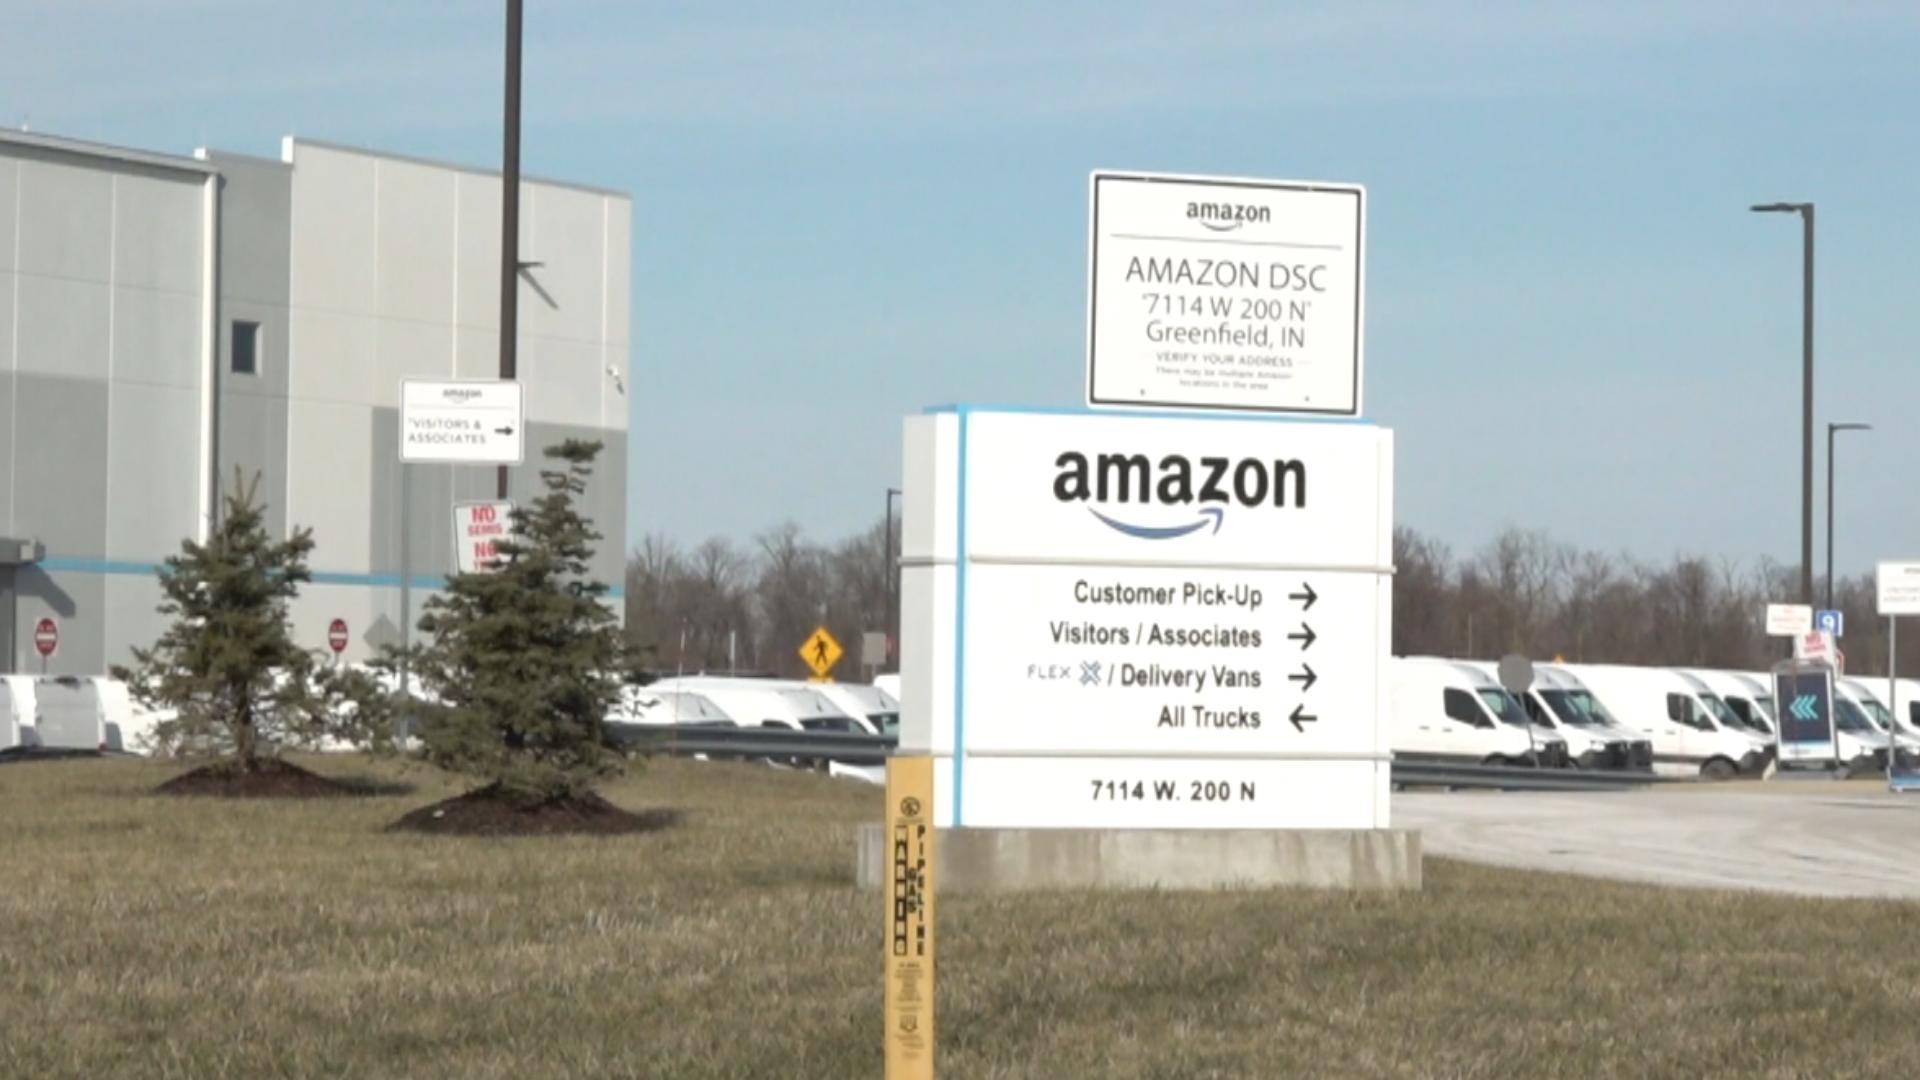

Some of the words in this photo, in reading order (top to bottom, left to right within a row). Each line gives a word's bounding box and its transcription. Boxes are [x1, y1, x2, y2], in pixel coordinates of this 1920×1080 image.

[1187, 202, 1270, 224] amazon
[1126, 256, 1258, 288] AMAZON
[1270, 264, 1325, 291] DSC
[1210, 297, 1232, 317] W
[1240, 298, 1282, 321] 200
[1146, 318, 1275, 348] Greenfield,
[1282, 327, 1304, 348] IN
[1155, 350, 1198, 363] VERIFY
[1203, 353, 1235, 365] YOUR
[1239, 355, 1293, 368] ADDRESS
[442, 388, 483, 400] amazon
[473, 420, 483, 430] &
[408, 433, 487, 444] ASSOCIATES
[1053, 452, 1305, 508] amazon
[472, 504, 496, 523] NO
[1075, 580, 1176, 605] Customer
[1183, 582, 1262, 611] Pick-Up
[1050, 622, 1130, 645] Visitors
[1136, 623, 1143, 645] /
[1148, 623, 1261, 647] Associates
[1028, 664, 1070, 679] FLEX
[1107, 664, 1115, 686] /
[1121, 663, 1206, 693] Delivery
[1212, 666, 1261, 688] Vans
[1158, 705, 1184, 727] All
[1192, 706, 1261, 728] Trucks
[1092, 780, 1144, 800] 7114
[1153, 780, 1180, 801] W.
[1191, 781, 1230, 801] 200
[1241, 782, 1255, 800] N
[917, 824, 926, 956] PIPELINE
